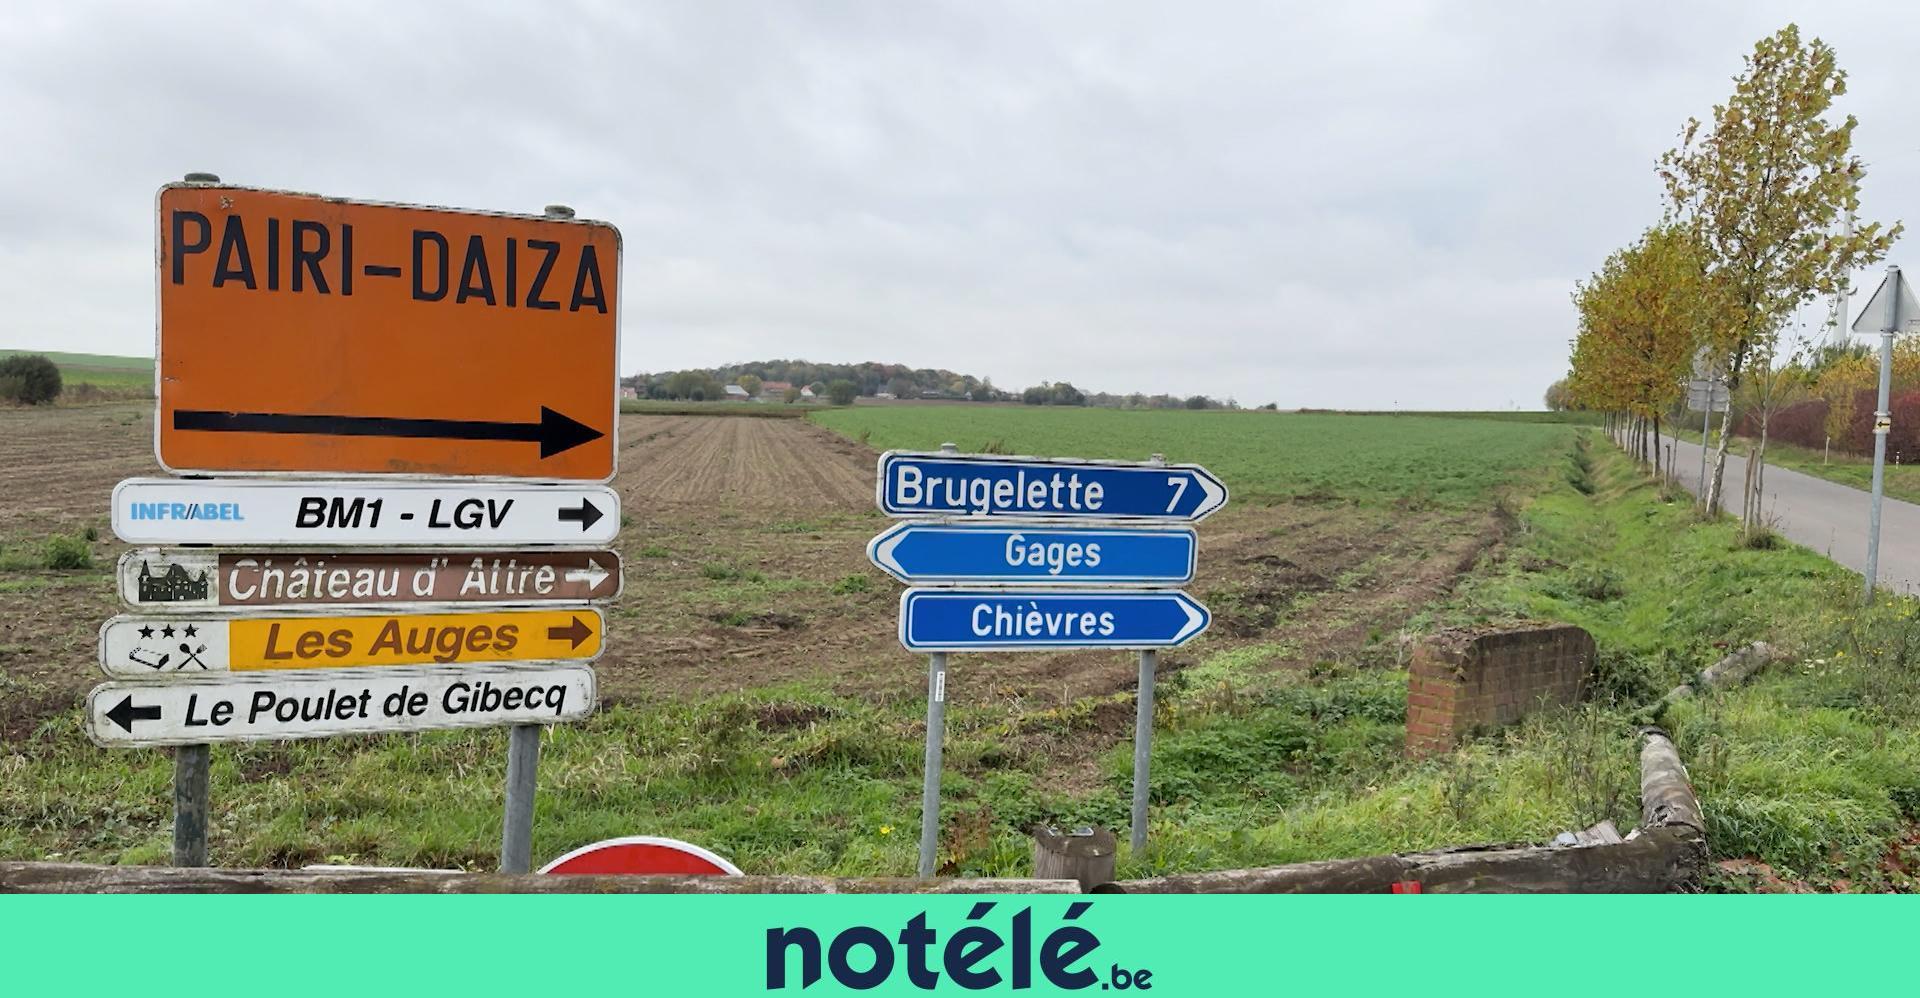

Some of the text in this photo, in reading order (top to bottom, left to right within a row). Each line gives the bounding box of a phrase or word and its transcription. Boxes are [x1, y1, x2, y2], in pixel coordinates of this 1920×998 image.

[171, 210, 608, 314] PAIRI-DAIZA
[896, 464, 1189, 516] Brugelette 7
[296, 497, 383, 529] BM1
[428, 498, 514, 530] LGV
[1005, 533, 1102, 576] Gages
[228, 558, 398, 600] Château
[459, 557, 556, 596] Attre
[263, 619, 519, 664] Les Auges
[971, 602, 1116, 637] Chièvres
[185, 681, 567, 727] Le Poulet de Gibecq
